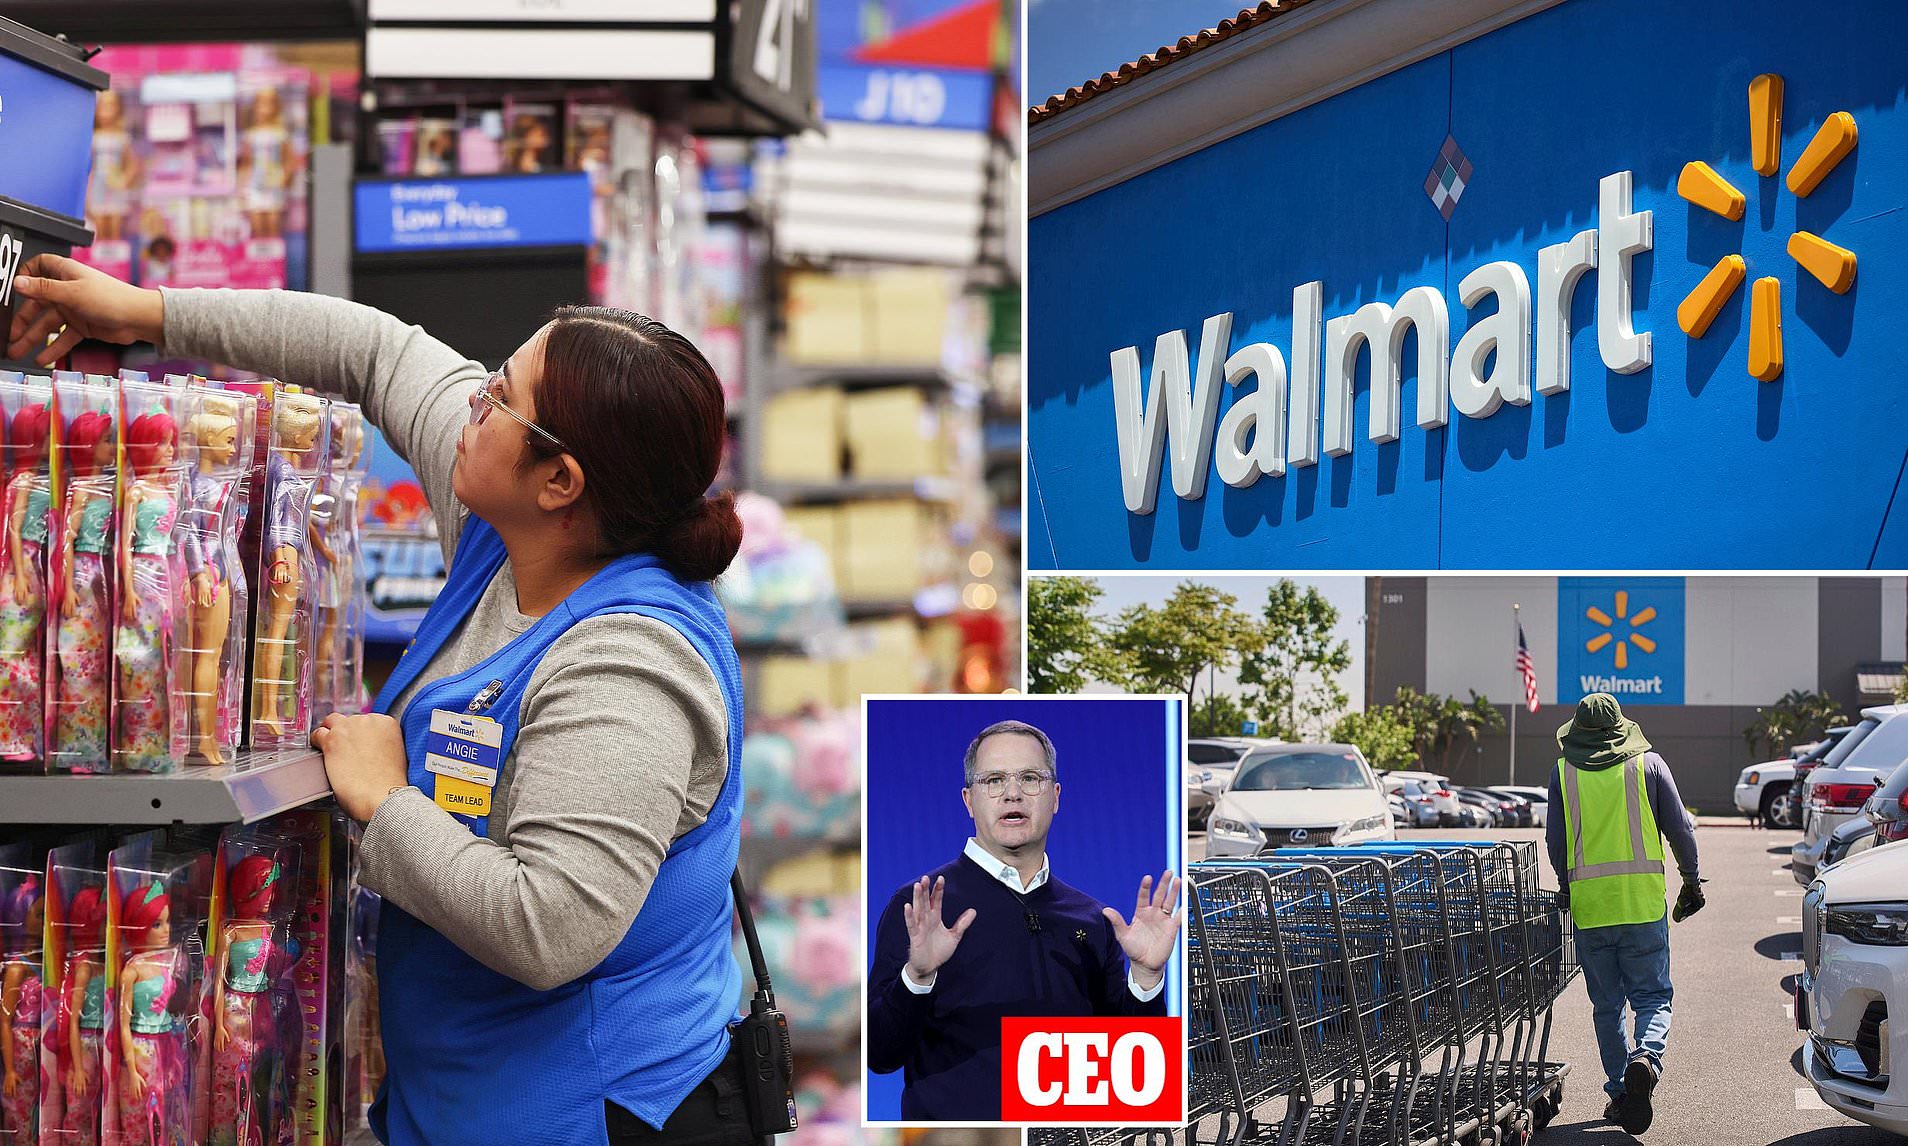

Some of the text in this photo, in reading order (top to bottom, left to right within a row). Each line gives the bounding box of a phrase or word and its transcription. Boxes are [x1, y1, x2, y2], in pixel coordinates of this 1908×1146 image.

[392, 201, 508, 232] Low Price
[1110, 170, 1653, 516] Walmart
[1580, 675, 1663, 694] Walmart
[448, 723, 475, 737] Walmart
[445, 742, 479, 760] ANGIE
[445, 793, 484, 806] TEAM LEAD
